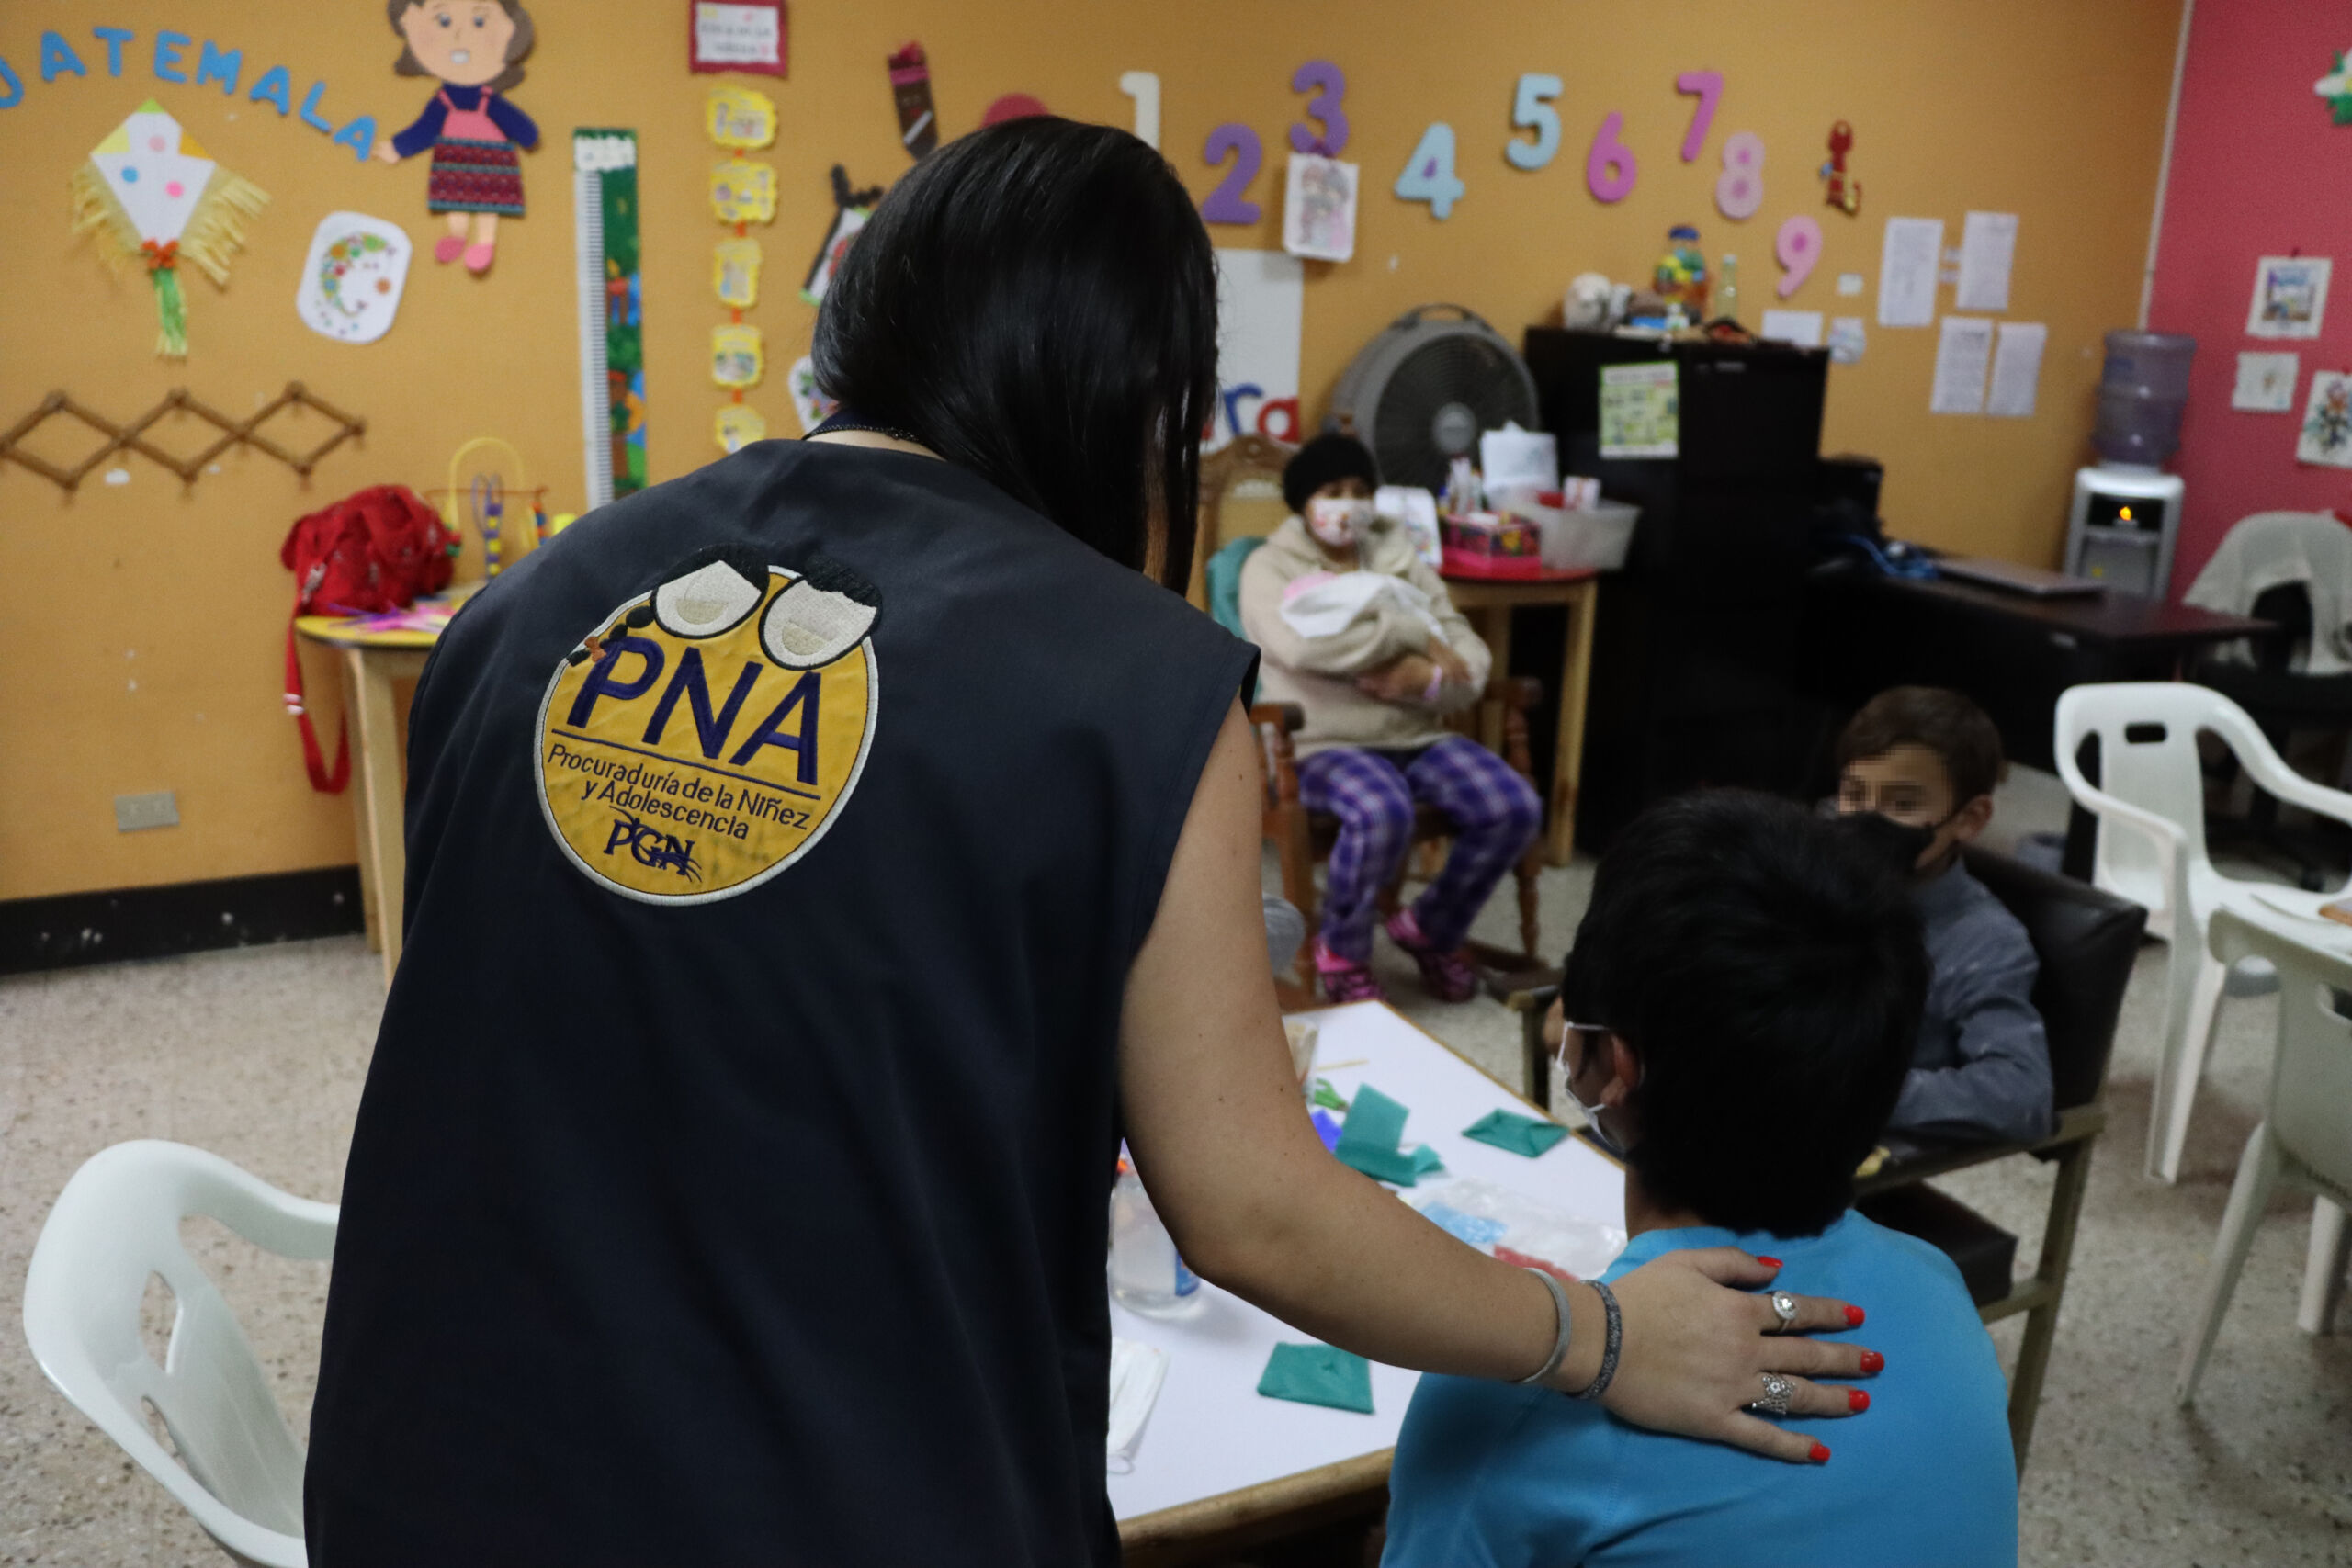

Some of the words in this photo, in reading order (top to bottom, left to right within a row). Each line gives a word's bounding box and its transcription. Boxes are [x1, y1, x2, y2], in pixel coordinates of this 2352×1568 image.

[1120, 71, 1160, 152] 1
[1202, 122, 1263, 225] 2
[1290, 60, 1350, 156] 3
[1394, 121, 1465, 220] 4
[1505, 73, 1564, 171] 5
[1586, 110, 1639, 204] 6
[1677, 70, 1725, 164] 7
[1715, 131, 1765, 220] 8
[1776, 215, 1823, 297] 9
[567, 636, 822, 786] PNA
[548, 743, 681, 795] Procuraduría
[681, 777, 714, 804] de
[715, 784, 733, 810] la
[737, 789, 811, 830] Niñez
[581, 780, 597, 801] y
[597, 782, 750, 840] Adolescencia
[604, 812, 699, 879] PGN
